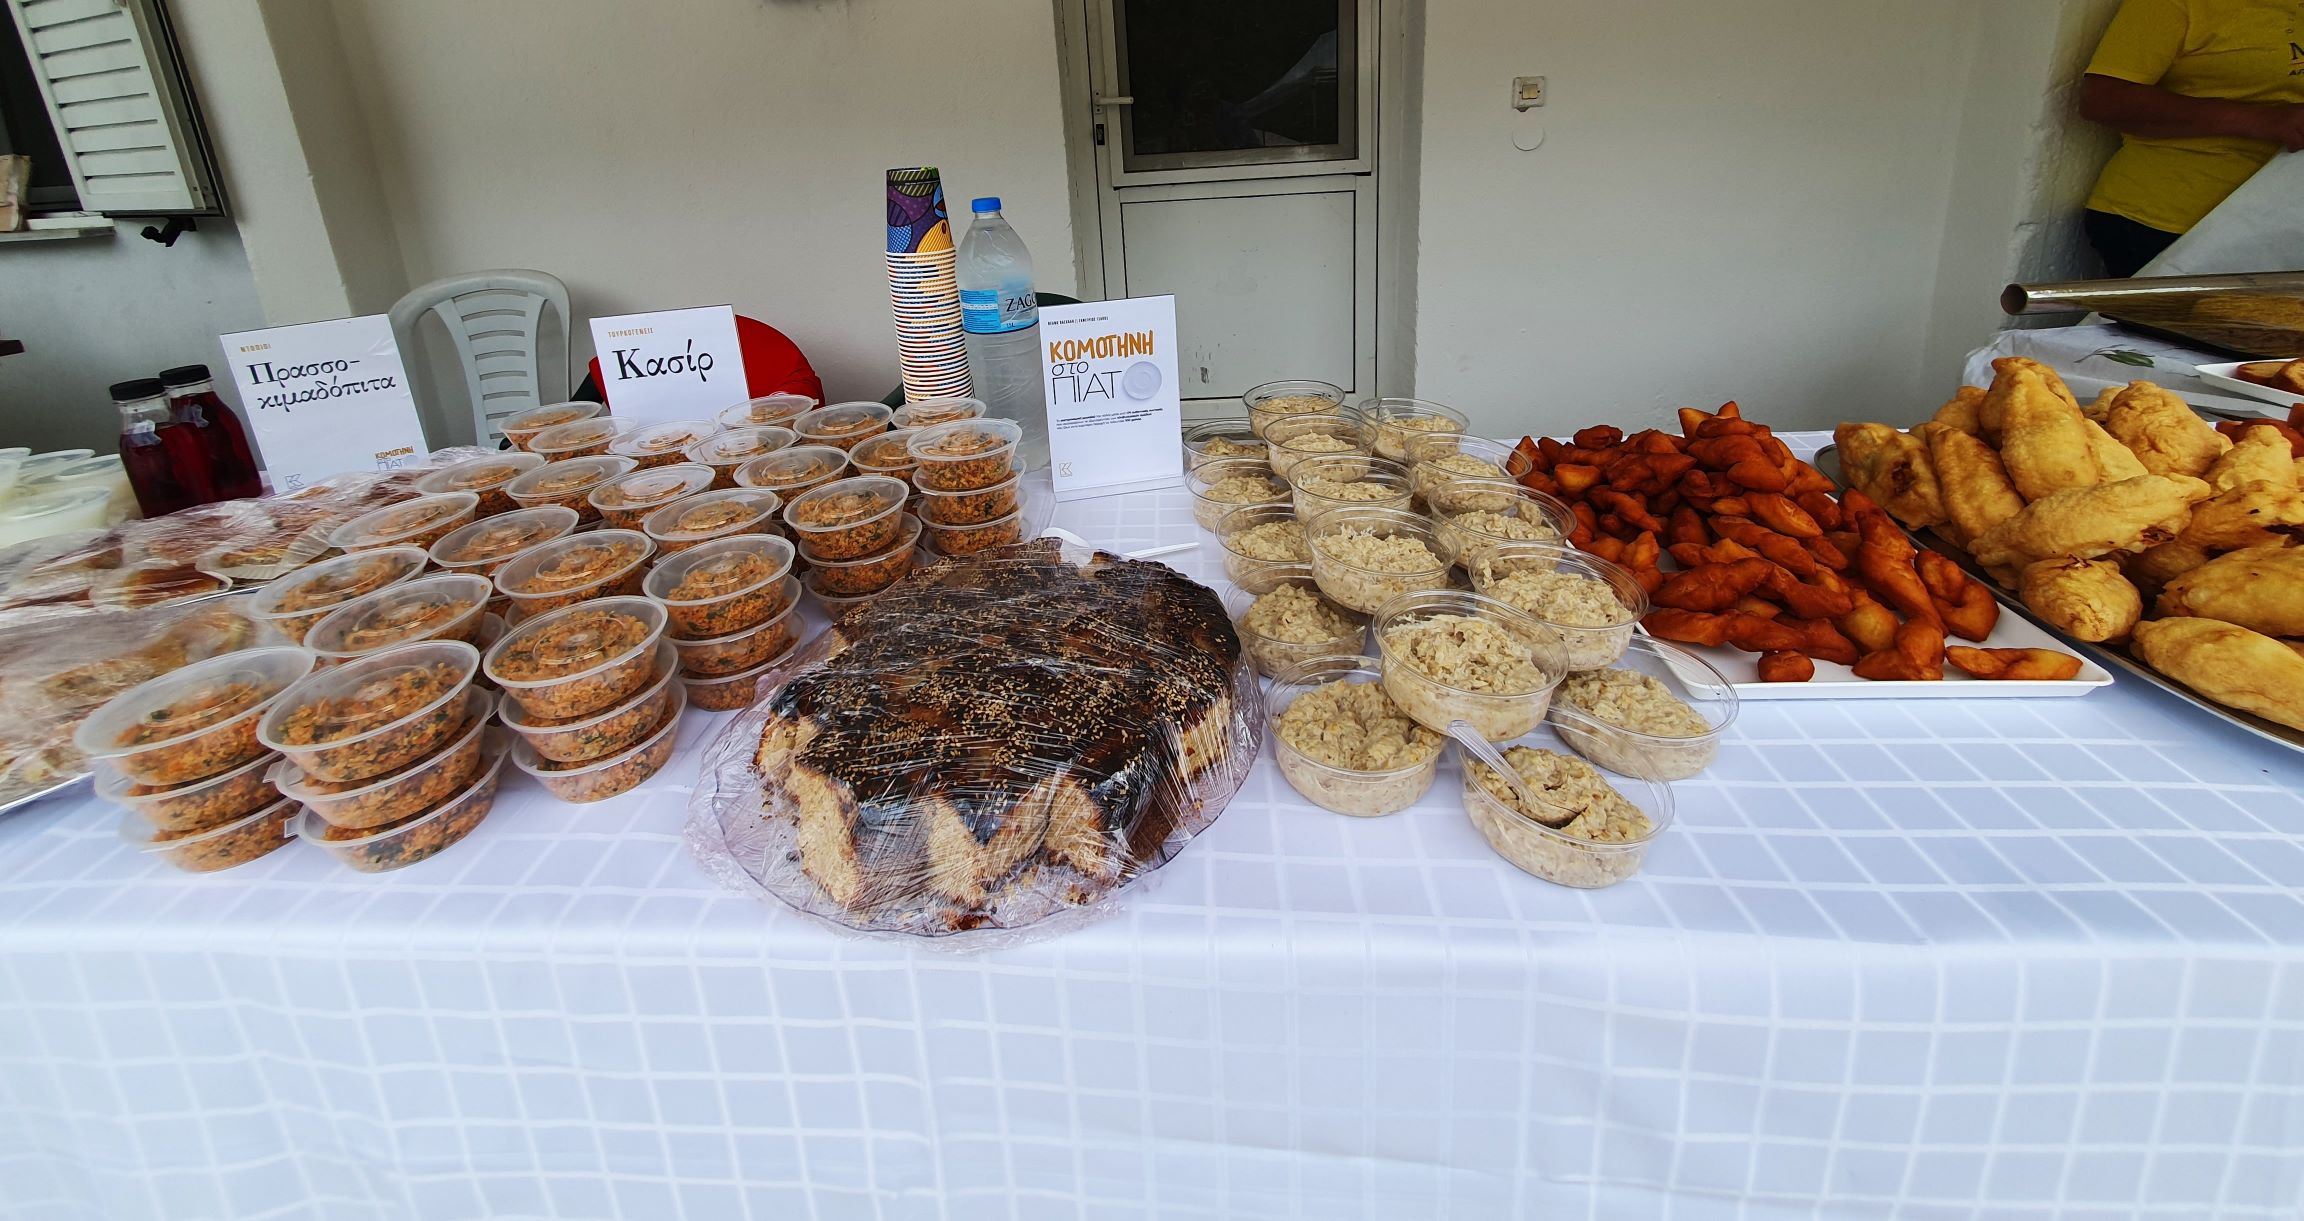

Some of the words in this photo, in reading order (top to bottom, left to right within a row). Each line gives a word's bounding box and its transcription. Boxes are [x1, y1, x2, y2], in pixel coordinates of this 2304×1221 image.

[612, 338, 714, 382] Κασίρ
[1049, 329, 1154, 363] ΚΟΜΟΤΗΝΗ
[247, 359, 360, 388] Πρασσο-
[1051, 361, 1089, 376] στο
[257, 375, 396, 412] κιμαδόπιτα
